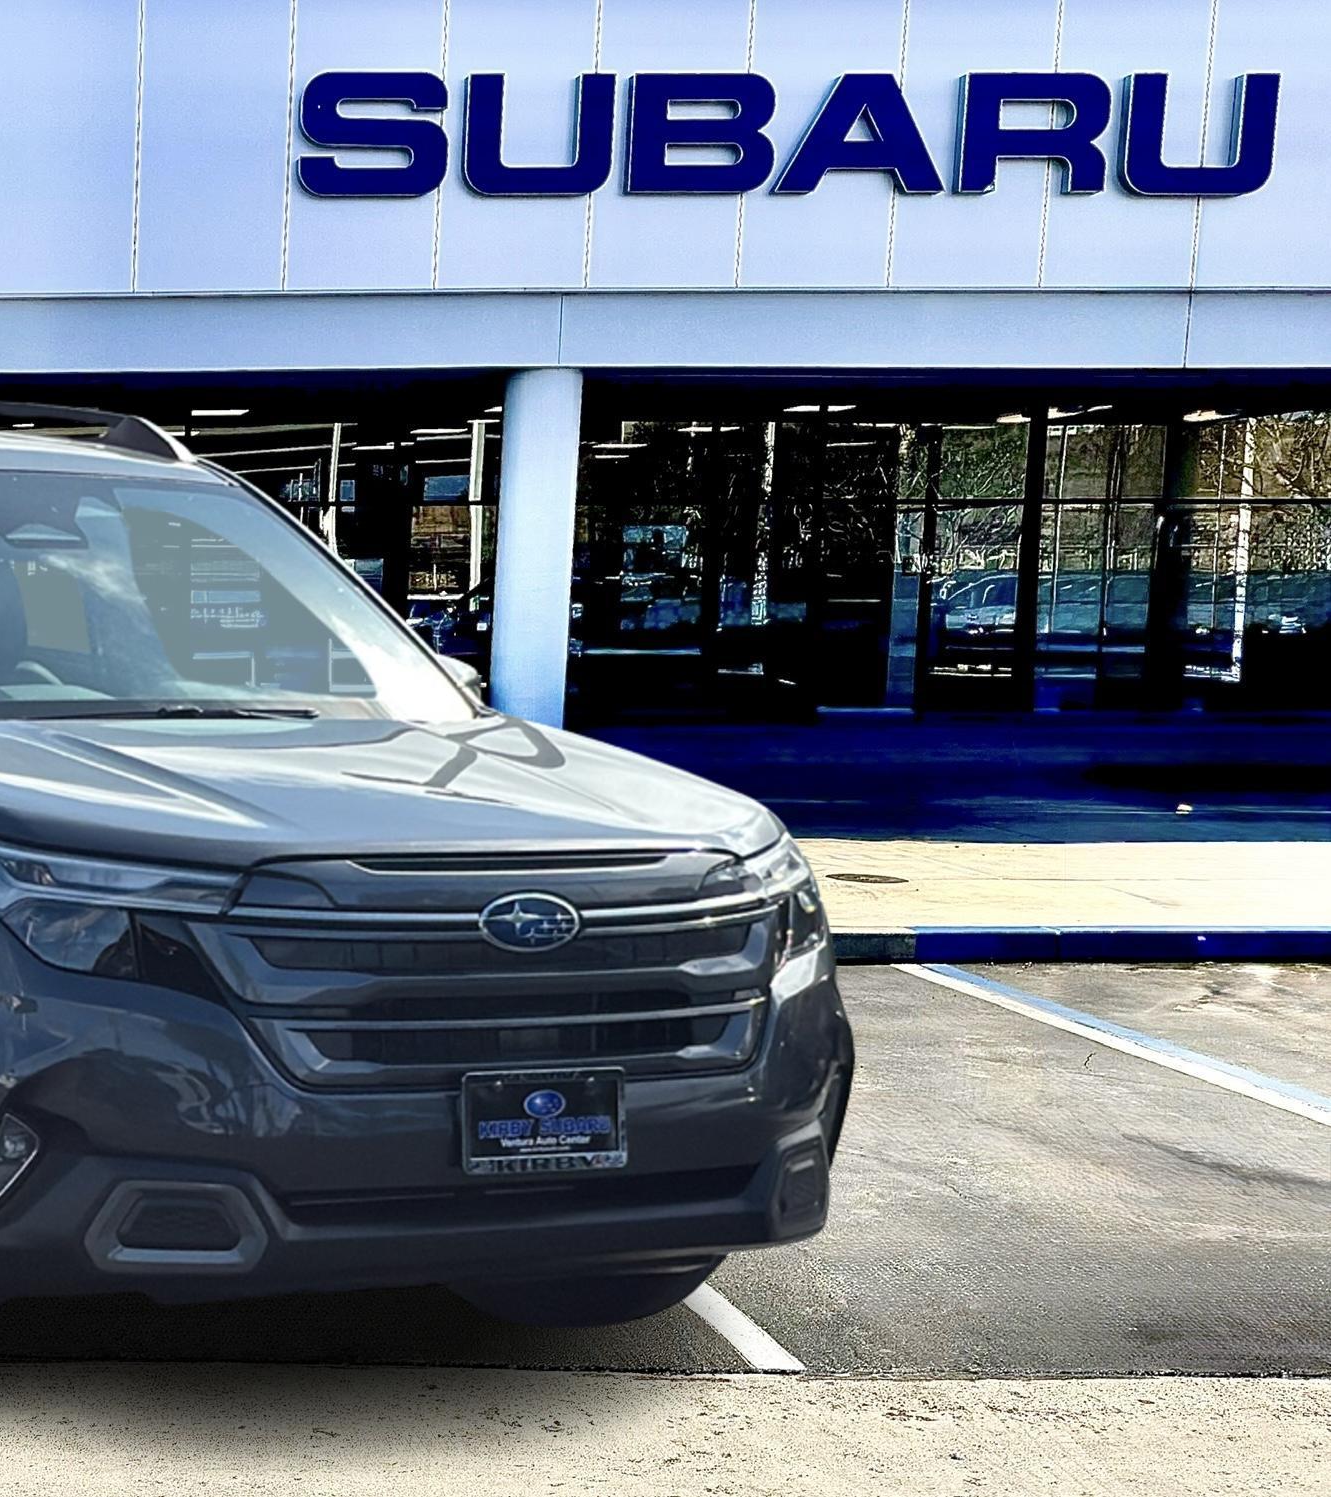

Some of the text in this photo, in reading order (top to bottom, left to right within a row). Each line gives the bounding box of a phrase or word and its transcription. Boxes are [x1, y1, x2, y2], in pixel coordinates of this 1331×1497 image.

[297, 71, 1281, 199] SUBARU
[478, 1115, 612, 1140] KIRBY SUBARU
[500, 1134, 591, 1148] Ventura Auto Center
[496, 1155, 595, 1173] KIRBY
